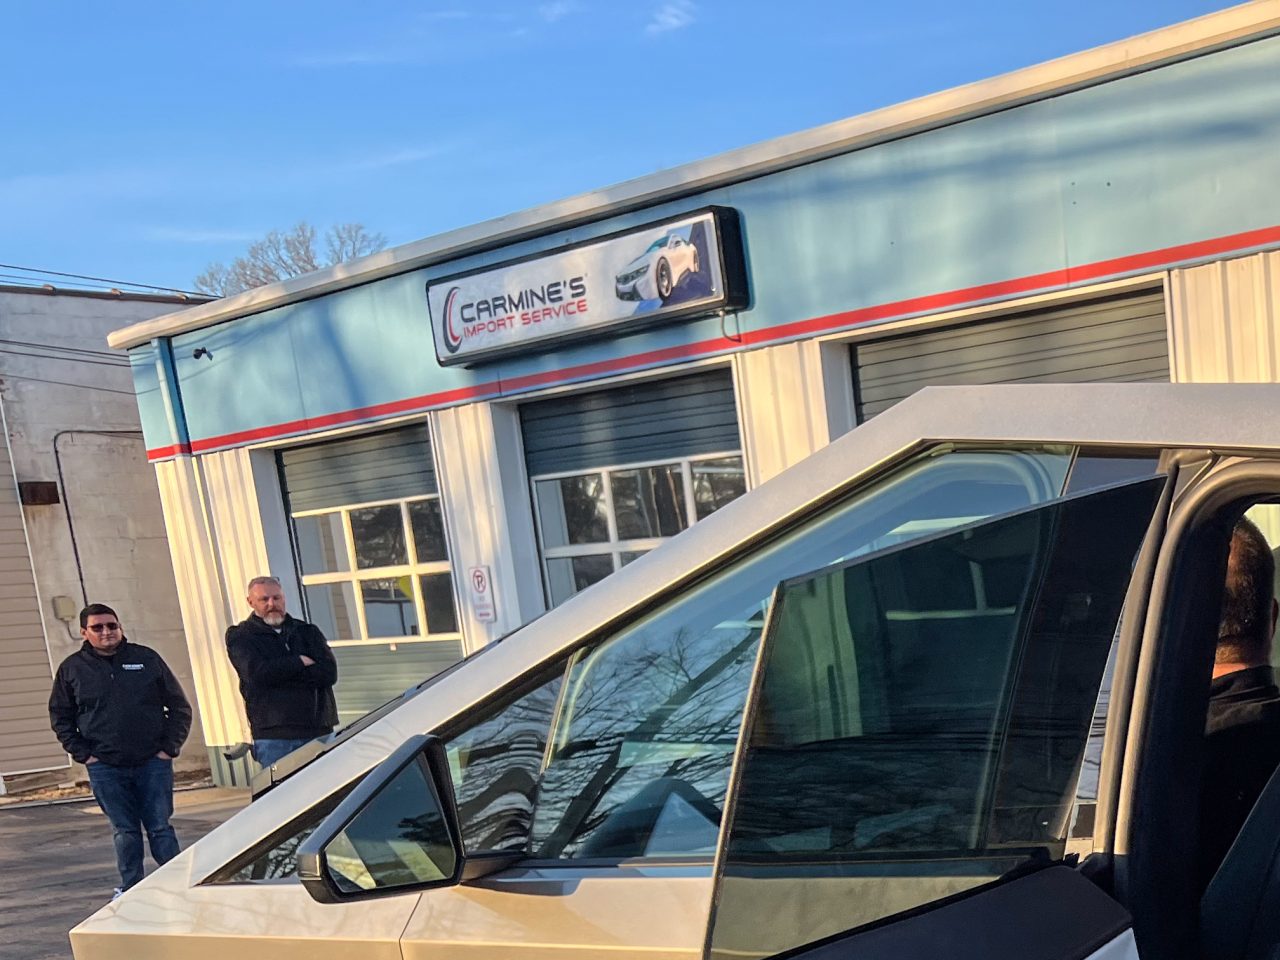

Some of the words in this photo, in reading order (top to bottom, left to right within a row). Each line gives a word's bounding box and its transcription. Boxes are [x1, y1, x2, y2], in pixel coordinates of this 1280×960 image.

[460, 276, 587, 323] CARMINE'S
[463, 315, 516, 338] IMPORT
[521, 299, 588, 325] SERVICE
